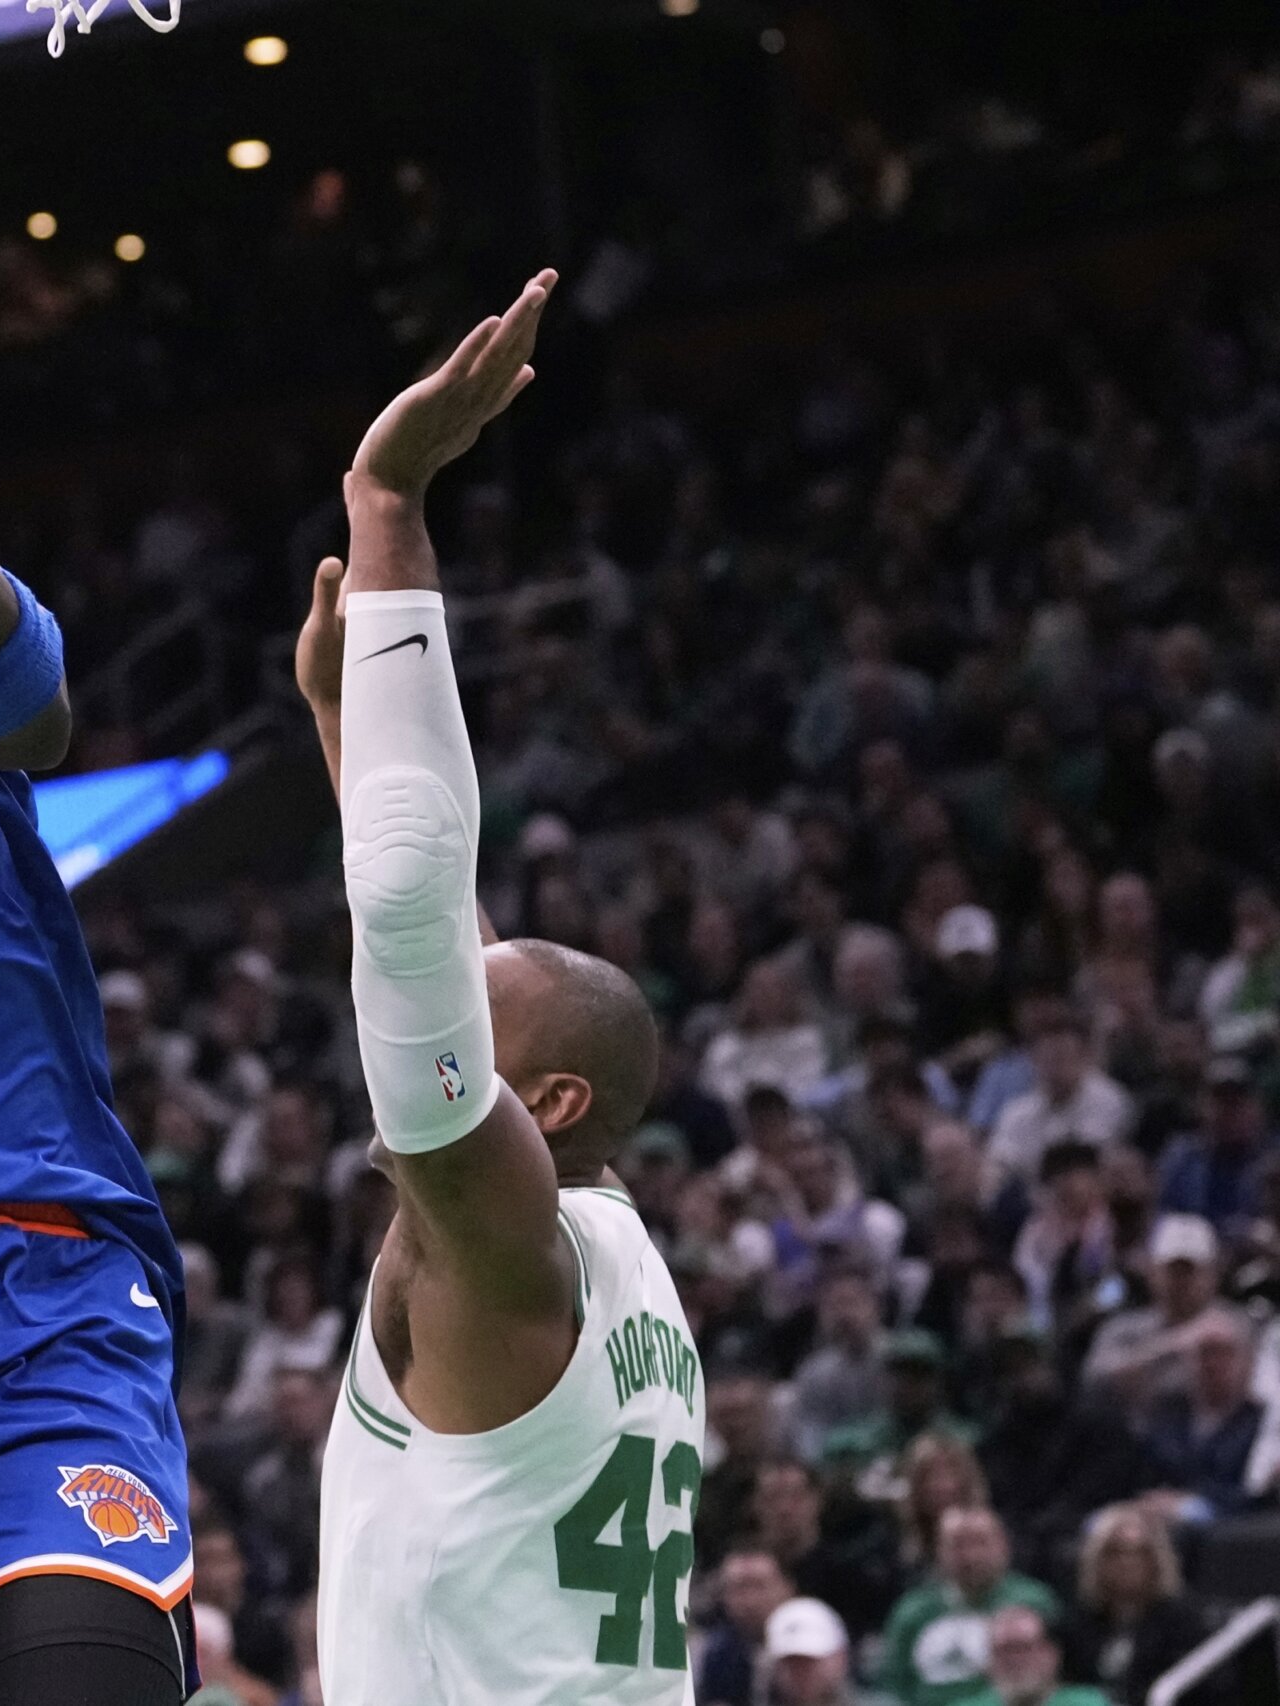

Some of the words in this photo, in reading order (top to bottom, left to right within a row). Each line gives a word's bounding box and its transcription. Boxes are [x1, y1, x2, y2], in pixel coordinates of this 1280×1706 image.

[62, 1467, 167, 1540] KNICKS
[106, 1467, 126, 1480] NEW
[554, 1434, 702, 1671] 42
